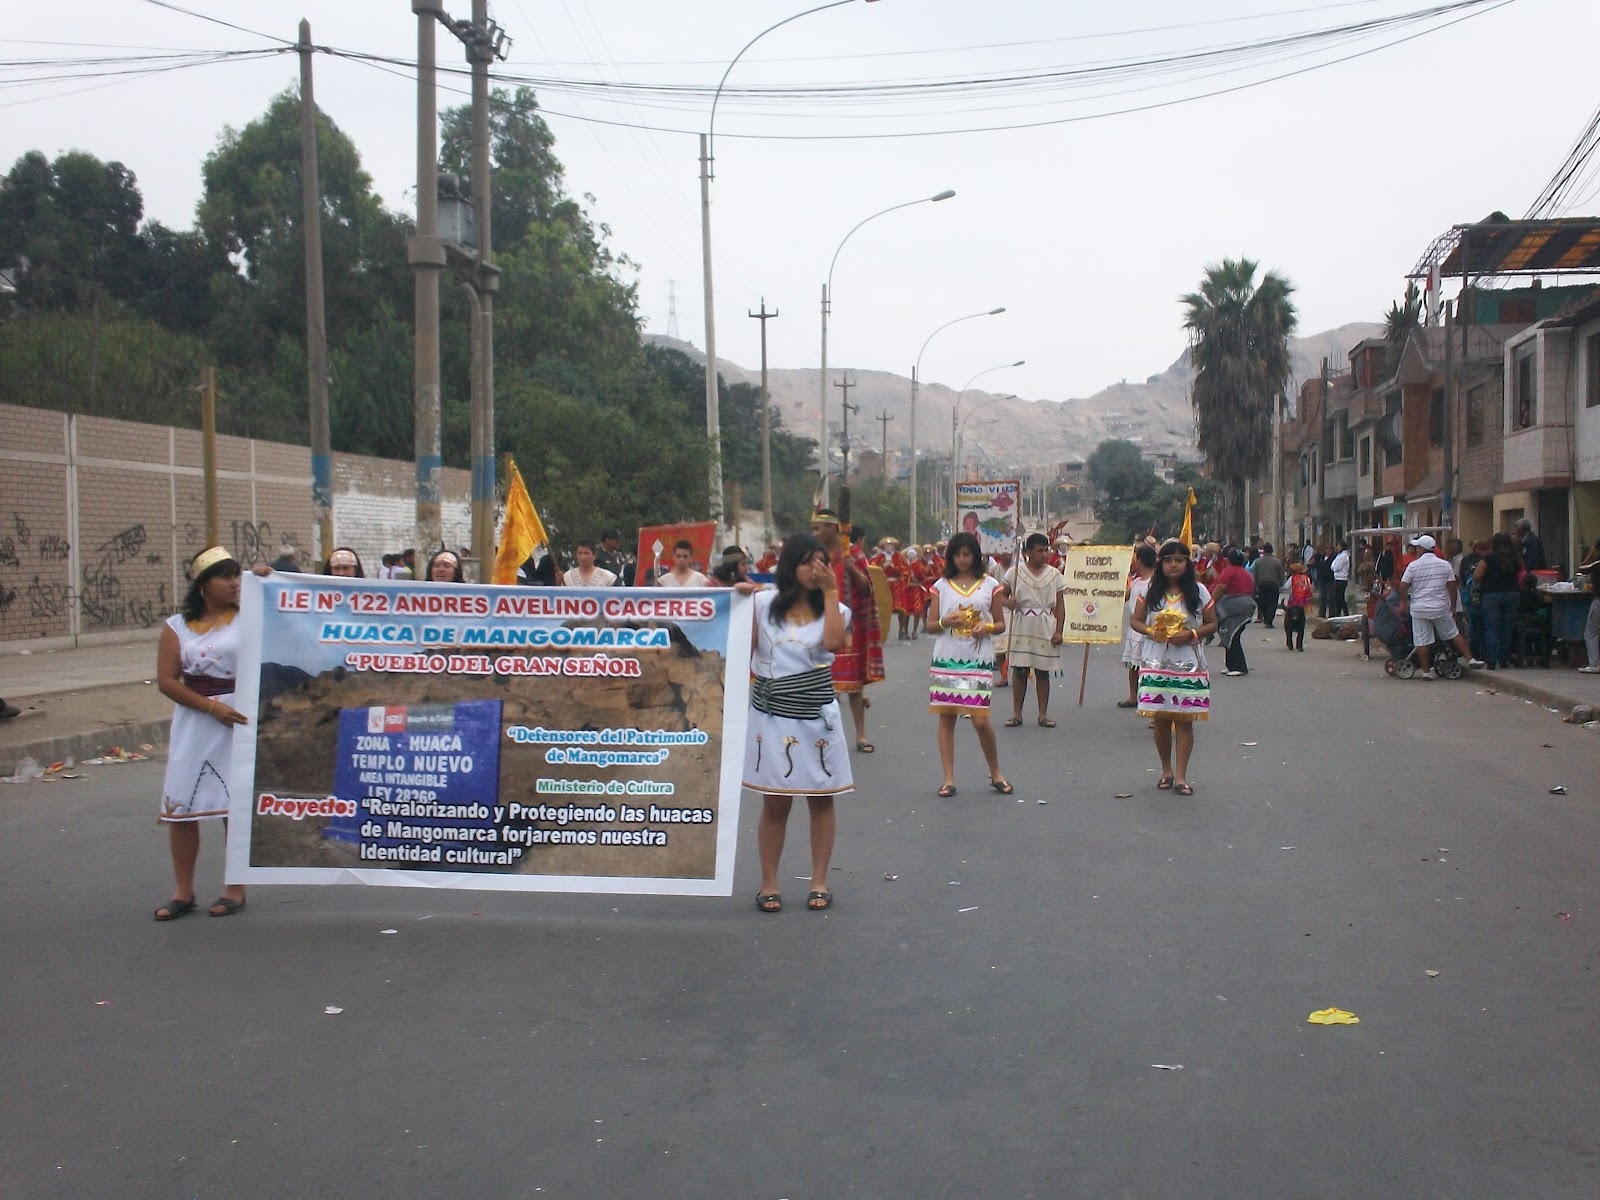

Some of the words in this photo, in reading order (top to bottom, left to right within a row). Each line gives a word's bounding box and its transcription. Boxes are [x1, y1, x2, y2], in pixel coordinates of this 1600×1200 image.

[350, 593, 389, 612] 122
[395, 595, 488, 614] ANDRES
[495, 597, 598, 617] AVELINO
[605, 599, 714, 618] CACERES
[321, 623, 414, 643] HUACA
[423, 627, 456, 644] DE
[462, 628, 669, 647] MANGOMARCA
[449, 656, 491, 673] DEL
[496, 657, 559, 675] GRAN
[564, 654, 640, 676] SEÑOR
[356, 735, 391, 751] ZONA
[409, 734, 463, 752] HUACA
[600, 729, 623, 743] del
[626, 730, 707, 744] Patrimonio
[351, 753, 406, 771] TEMPLO
[413, 755, 474, 774] NUEVO
[546, 749, 564, 763] de
[359, 771, 384, 784] AREA
[385, 773, 448, 788] INTANGIBLE
[537, 780, 603, 793] Ministerio
[607, 782, 623, 793] de
[627, 782, 673, 793] Cultura
[368, 785, 393, 801] LEY
[259, 796, 356, 818] Proyecto:
[493, 806, 505, 823] y
[509, 803, 616, 825] Protegiendo
[620, 805, 645, 822] las
[649, 807, 713, 824] huacas
[361, 821, 383, 838] de
[387, 822, 497, 843] Mangomarca
[502, 826, 597, 846] forjaremos
[600, 828, 667, 846] nuestra
[360, 842, 441, 863] Identidad
[445, 847, 522, 865] cultural”
